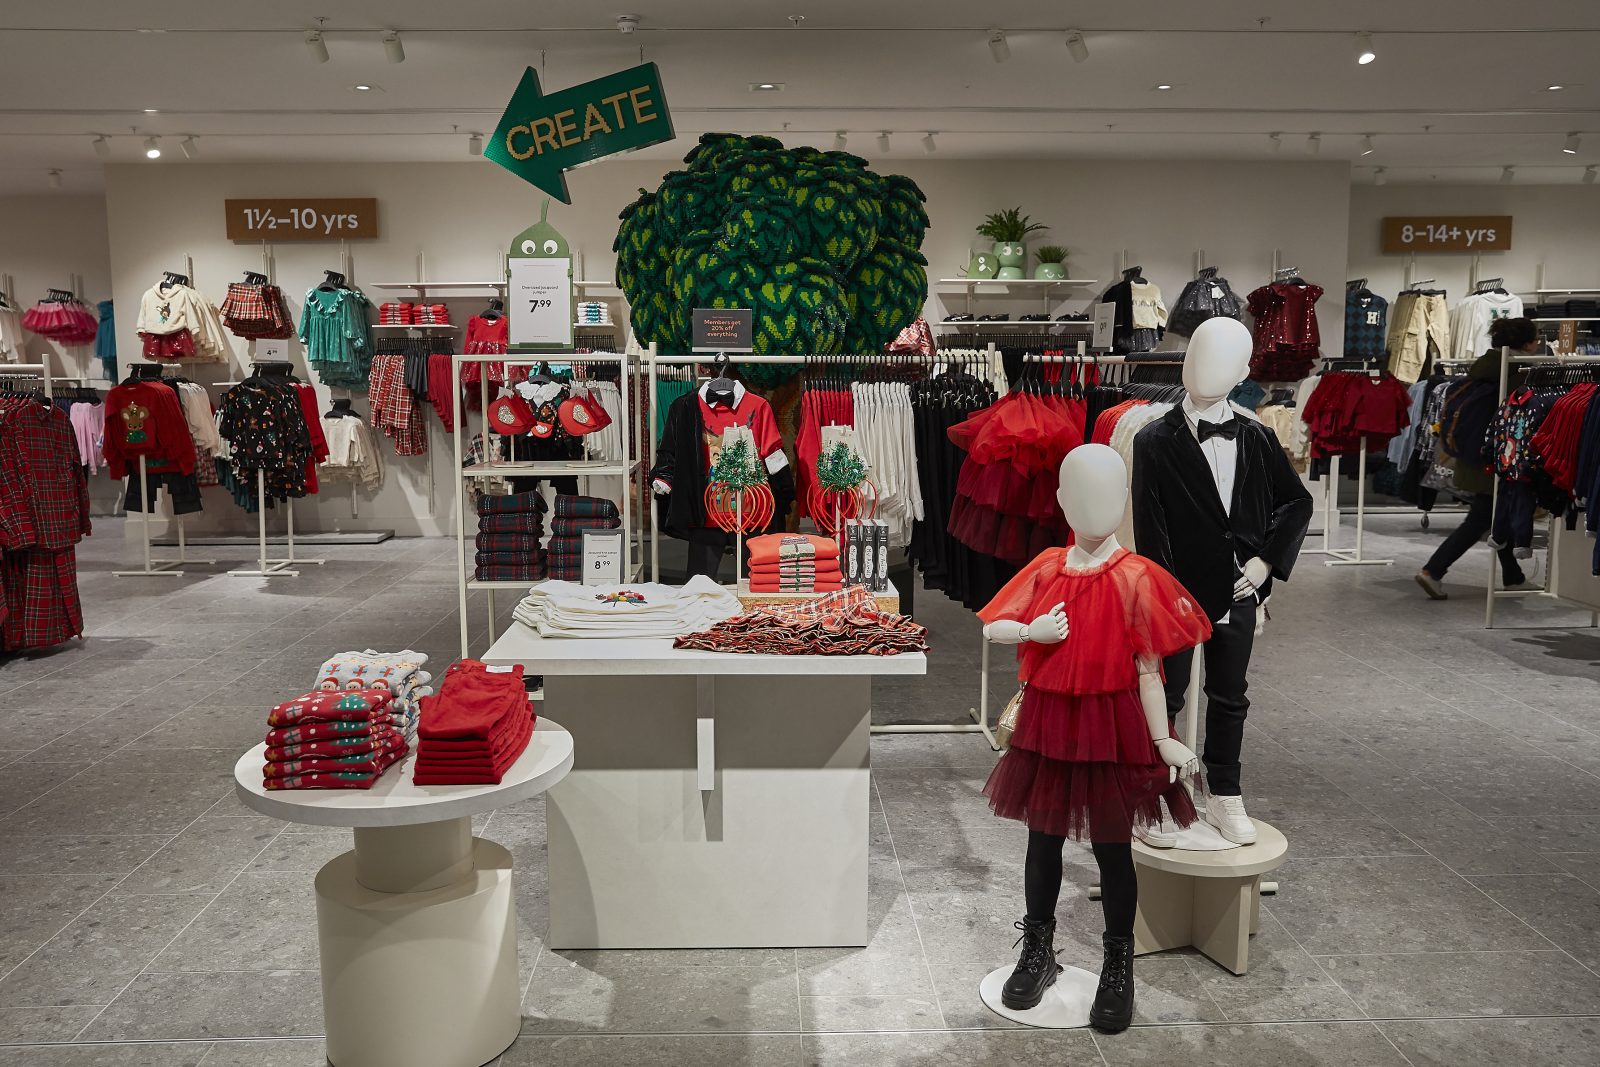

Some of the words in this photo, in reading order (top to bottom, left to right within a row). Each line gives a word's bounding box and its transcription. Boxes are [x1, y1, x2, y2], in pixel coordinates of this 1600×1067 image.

[505, 85, 657, 160] CREATE
[321, 214, 359, 235] yrs
[1465, 229, 1496, 247] yrs
[529, 300, 552, 313] 7.99
